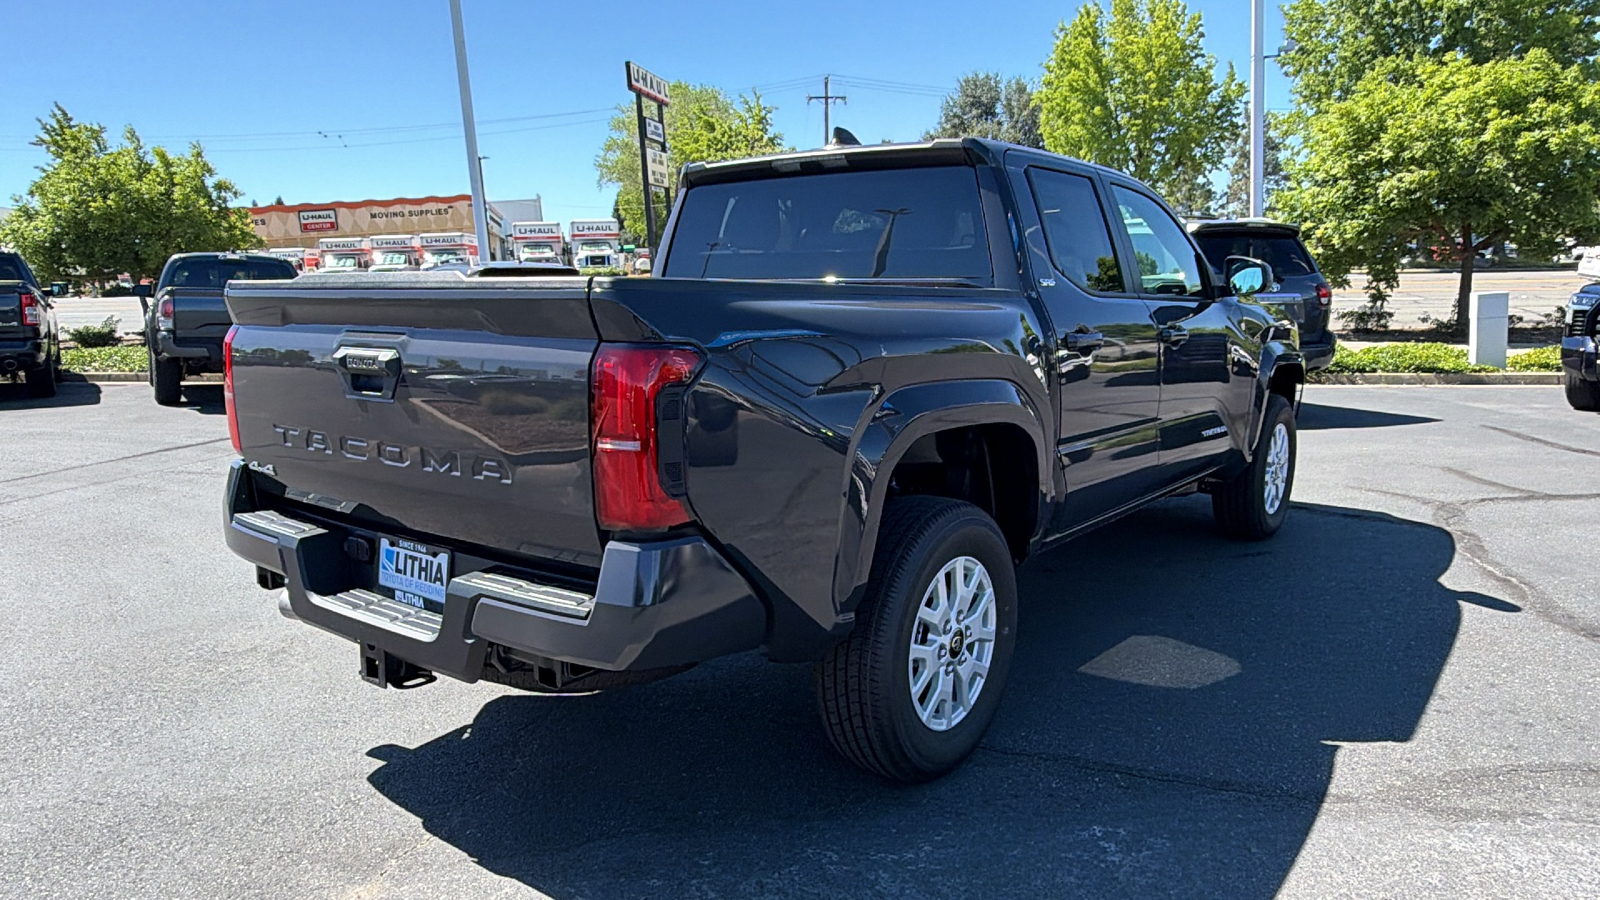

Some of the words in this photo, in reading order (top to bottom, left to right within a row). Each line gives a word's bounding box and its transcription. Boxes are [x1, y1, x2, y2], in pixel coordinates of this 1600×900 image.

[302, 213, 334, 221] U-HAUL
[370, 211, 405, 220] MOVING
[408, 207, 449, 217] SUPPLIES
[306, 222, 332, 230] CENTER
[376, 239, 407, 247] U-HAUL
[425, 237, 458, 245] U-HAUL
[272, 423, 513, 485] TACOMA
[399, 540, 414, 550] SINCE
[414, 543, 427, 553] 1946
[394, 551, 445, 587] LITHIA
[381, 571, 404, 586] TOYOTA
[404, 579, 414, 588] OF
[414, 581, 445, 598] REDDING
[400, 591, 425, 609] LITHIA
